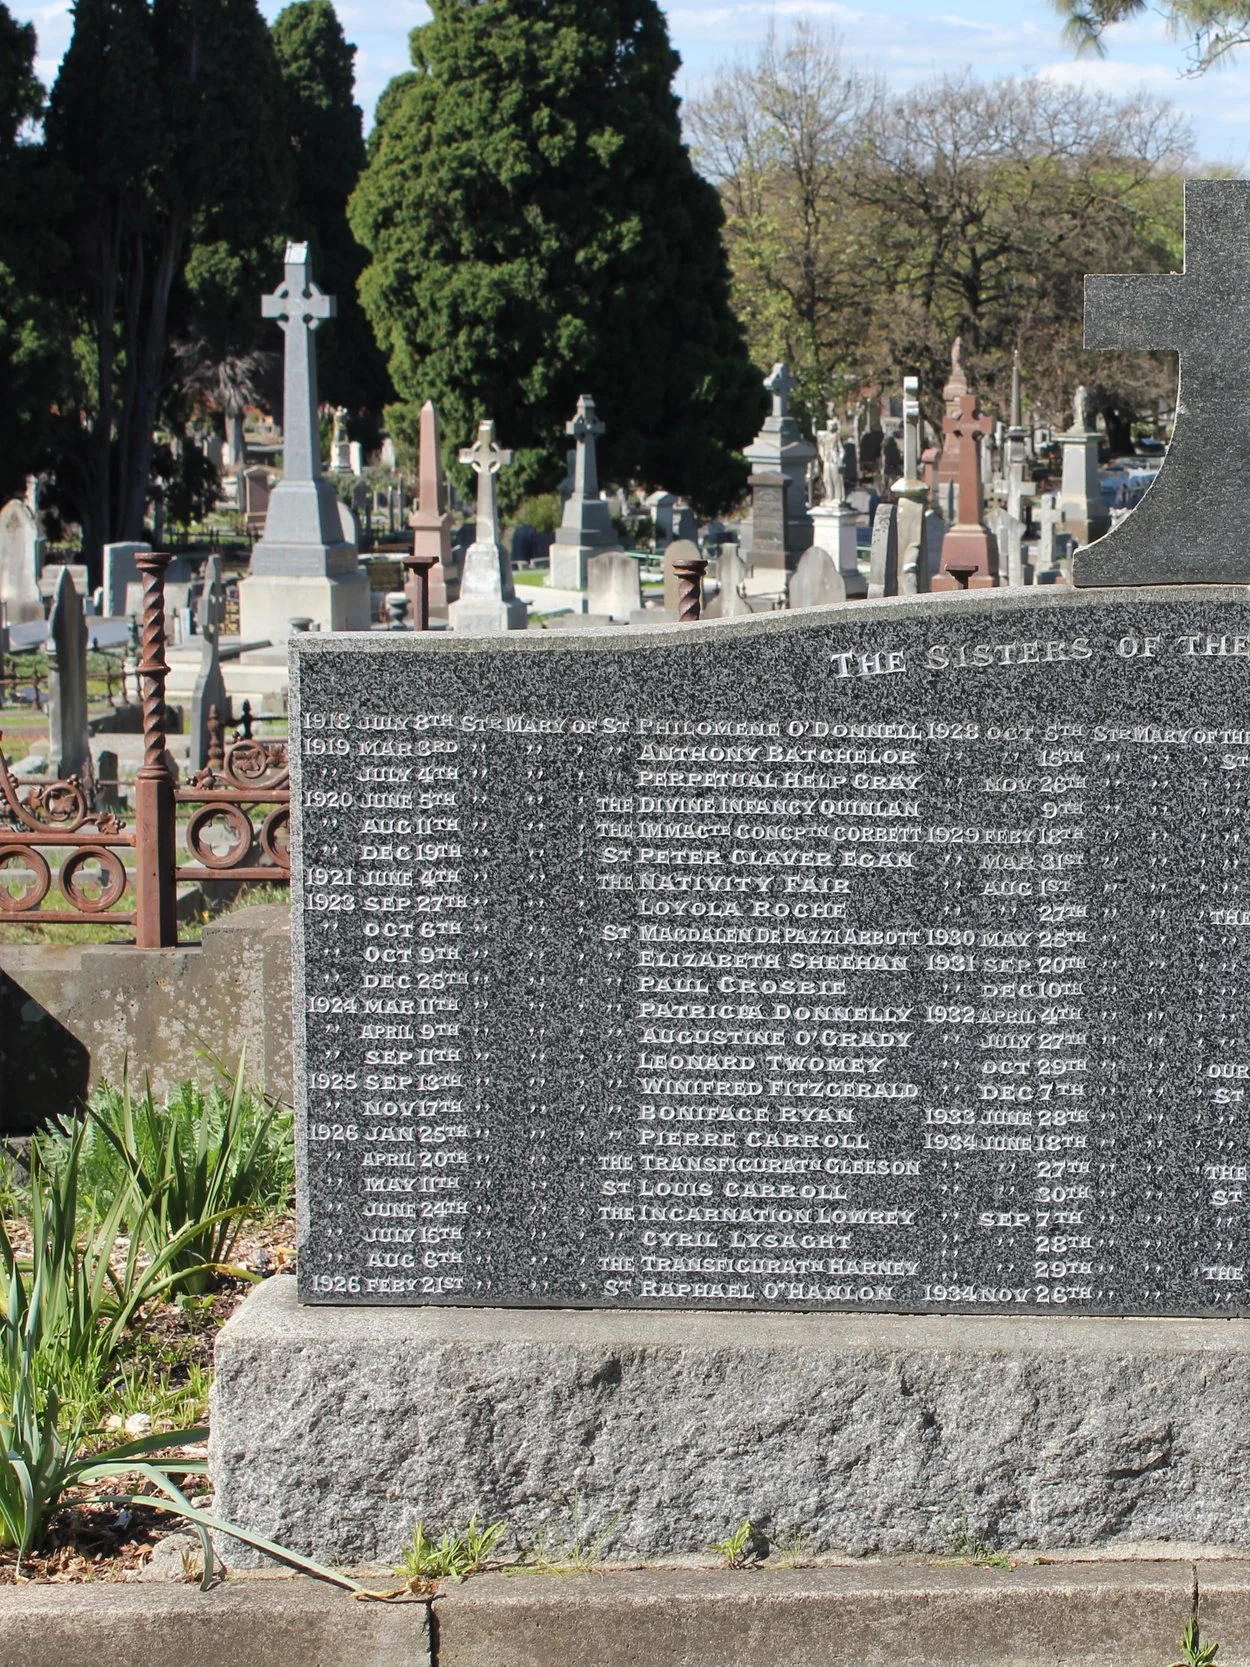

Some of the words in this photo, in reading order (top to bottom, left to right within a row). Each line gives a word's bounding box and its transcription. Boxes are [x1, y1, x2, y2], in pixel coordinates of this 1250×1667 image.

[831, 651, 907, 680] THE
[926, 637, 1092, 670] SISTERS
[1117, 635, 1161, 658] OF
[1178, 634, 1250, 657] THE
[302, 713, 351, 730] 1918
[356, 715, 410, 730] JULY
[505, 716, 564, 733] MARY
[636, 719, 779, 736] PHILOMENE
[927, 722, 979, 739] 1928
[303, 740, 350, 755] 1919
[636, 744, 760, 762] ANTHONY
[764, 746, 920, 764] BATCHELOR
[636, 771, 780, 788] PERPETUAL
[784, 772, 848, 789] HELP
[854, 772, 926, 790] GRAY
[303, 792, 354, 807] 1920
[358, 795, 412, 809] JUNE
[637, 797, 716, 813] DIVINE
[719, 799, 818, 815] INFANCY
[820, 801, 921, 818] QUINLAN
[833, 826, 923, 843] CORBETT
[927, 828, 980, 844] 1929
[360, 846, 412, 860] DEC
[638, 849, 725, 865] PETER
[731, 850, 834, 866] CLAVER
[839, 852, 915, 867] EGAN
[305, 870, 354, 885] 1921
[639, 874, 775, 891] NATIVITY
[784, 876, 850, 893] FAIR
[306, 895, 355, 910] 1923
[363, 897, 411, 911] SEP
[637, 899, 744, 916] LOYOLA
[751, 902, 847, 918] ROCHE
[639, 926, 752, 943] MAGDALEN
[842, 928, 920, 945] ABBOTT
[928, 930, 975, 945] 1930
[636, 951, 781, 969] ELIZABETH
[788, 953, 911, 970] SHEEHAN
[925, 954, 974, 971] 1931
[636, 977, 709, 993] PAUL
[720, 977, 845, 994] CROSBIE
[308, 998, 357, 1013] 1924
[636, 1003, 762, 1019] PATRICIA
[772, 1003, 913, 1021] DONNELLY
[924, 1006, 974, 1023] 1932
[638, 1026, 785, 1045] AUGUSTINE
[638, 1053, 755, 1070] LEONARD
[766, 1054, 887, 1073] TWOMEY
[310, 1073, 357, 1089] 1925
[640, 1079, 763, 1096] WINIFRED
[770, 1081, 918, 1097] FITZGERALD
[638, 1105, 770, 1122] BONIFACE
[311, 1125, 359, 1140] 1926
[638, 1130, 736, 1146] PIERRE
[747, 1131, 868, 1149] CARROLL
[362, 1153, 414, 1166] APRIL
[824, 1158, 920, 1175] GLEESON
[639, 1181, 712, 1197] LOUIS
[641, 1206, 814, 1223] INCARNATION
[643, 1231, 718, 1247] CYRIL
[730, 1231, 851, 1249] LYSAGHT
[826, 1259, 920, 1275] HARNEY
[312, 1276, 360, 1291] 1926
[640, 1281, 754, 1298] RAPHAEL
[924, 1284, 978, 1301] 1934
